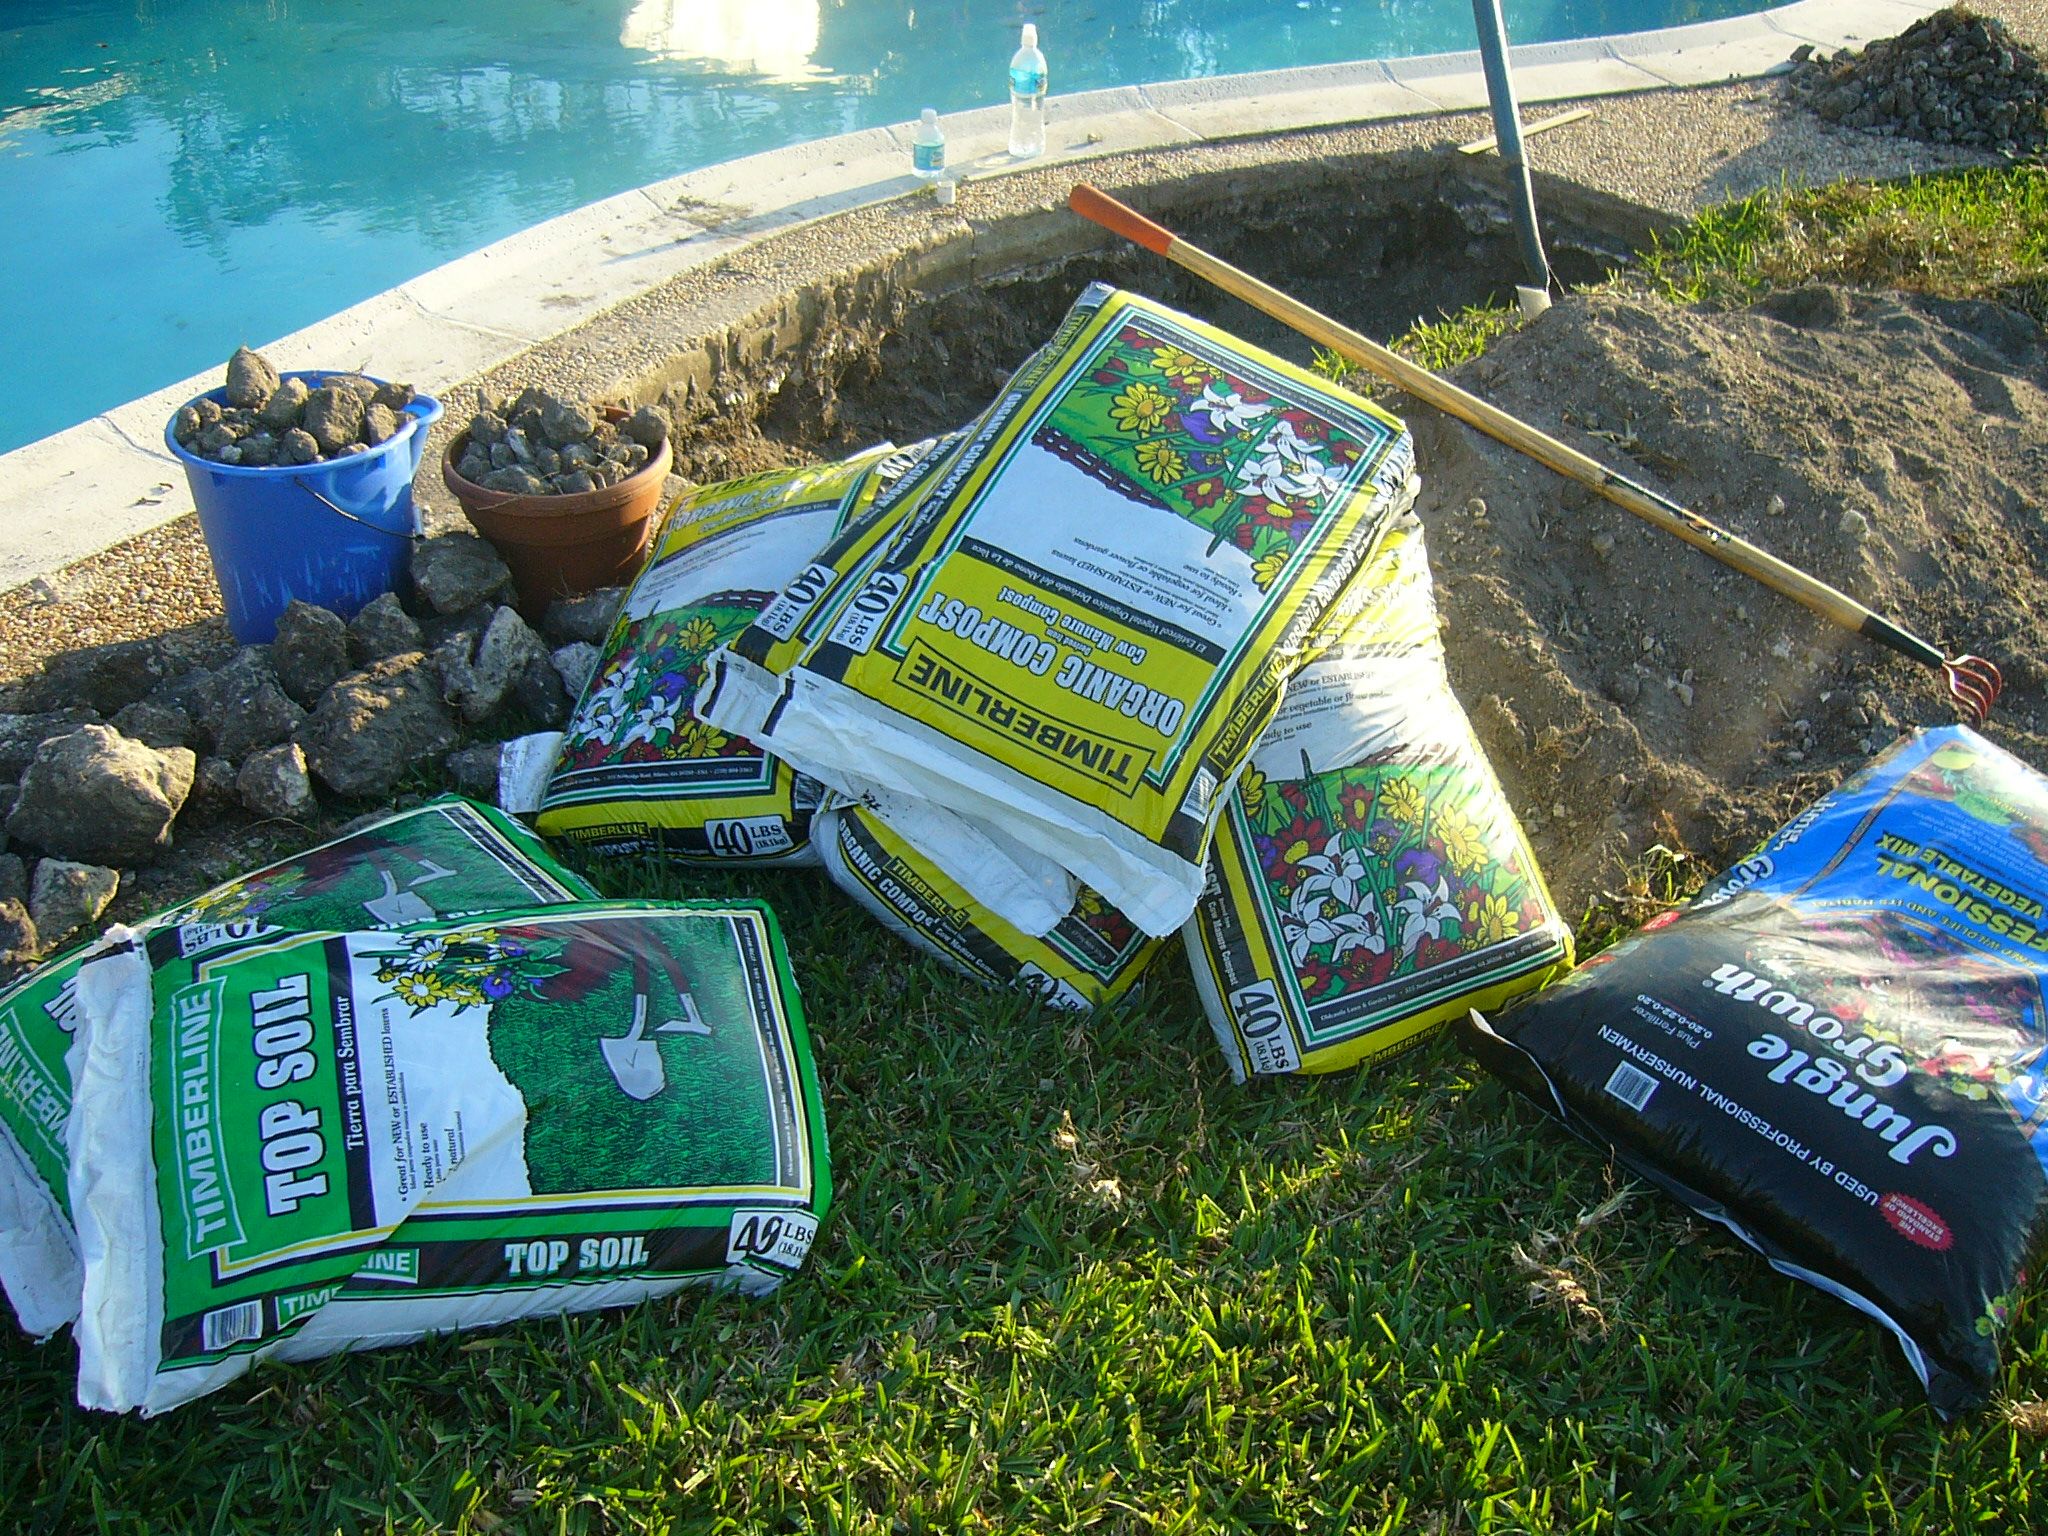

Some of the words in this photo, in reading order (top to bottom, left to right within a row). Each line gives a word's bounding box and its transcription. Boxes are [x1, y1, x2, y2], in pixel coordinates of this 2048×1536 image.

[1050, 547, 1077, 565] lawns
[782, 563, 828, 610] 40
[1075, 558, 1142, 593] ESTABLISHED
[1141, 587, 1154, 597] or
[852, 569, 902, 622] 40
[994, 582, 1061, 627] Compost
[1152, 592, 1177, 608] NEW
[1175, 601, 1192, 615] for
[772, 603, 800, 635] LBS
[847, 612, 874, 648] LBS
[916, 588, 1059, 678] COMPOST
[1057, 613, 1116, 652] Manure
[1190, 608, 1217, 627] Great
[1113, 638, 1147, 665] Cow
[1051, 650, 1187, 738] ORGANIC
[907, 652, 1138, 787] TIMBERLINE
[569, 823, 646, 841] TIMBERLINE
[713, 821, 753, 856] 40
[750, 824, 782, 838] LBS
[1875, 827, 1919, 865] MIX
[1871, 847, 2048, 954] FESSIONAL
[1918, 845, 2045, 920] VEGETABLE
[248, 971, 317, 1091] SOIL
[333, 994, 355, 1058] Sembrar
[379, 1007, 391, 1034] lawns
[1230, 983, 1284, 1041] 40
[1265, 1033, 1290, 1070] LBS
[1630, 1001, 1676, 1035] Fertilizer
[1705, 954, 1909, 1097] Growth
[1596, 1022, 1698, 1091] NURSERYMEN
[1674, 1027, 1701, 1049] Plus
[342, 1059, 362, 1095] para
[382, 1035, 399, 1104] ESTABLISHED
[390, 1106, 401, 1118] or
[1744, 1024, 1960, 1167] Jungle
[173, 990, 231, 1243] TIMBERLINE
[343, 1098, 365, 1150] Tierra
[390, 1119, 403, 1144] NEW
[418, 1121, 428, 1140] use
[1695, 1079, 1810, 1161] PROFESSIONAL
[258, 1097, 331, 1216] TOP
[393, 1145, 406, 1162] for
[420, 1141, 430, 1153] to
[443, 1126, 458, 1164] natural
[395, 1164, 409, 1194] Great
[421, 1155, 435, 1188] Ready
[1808, 1152, 1835, 1177] BY
[1832, 1168, 1880, 1205] USED
[732, 1209, 785, 1259] 40
[782, 1221, 815, 1244] LBS
[503, 1237, 571, 1278] TOP
[576, 1231, 651, 1273] SOIL
